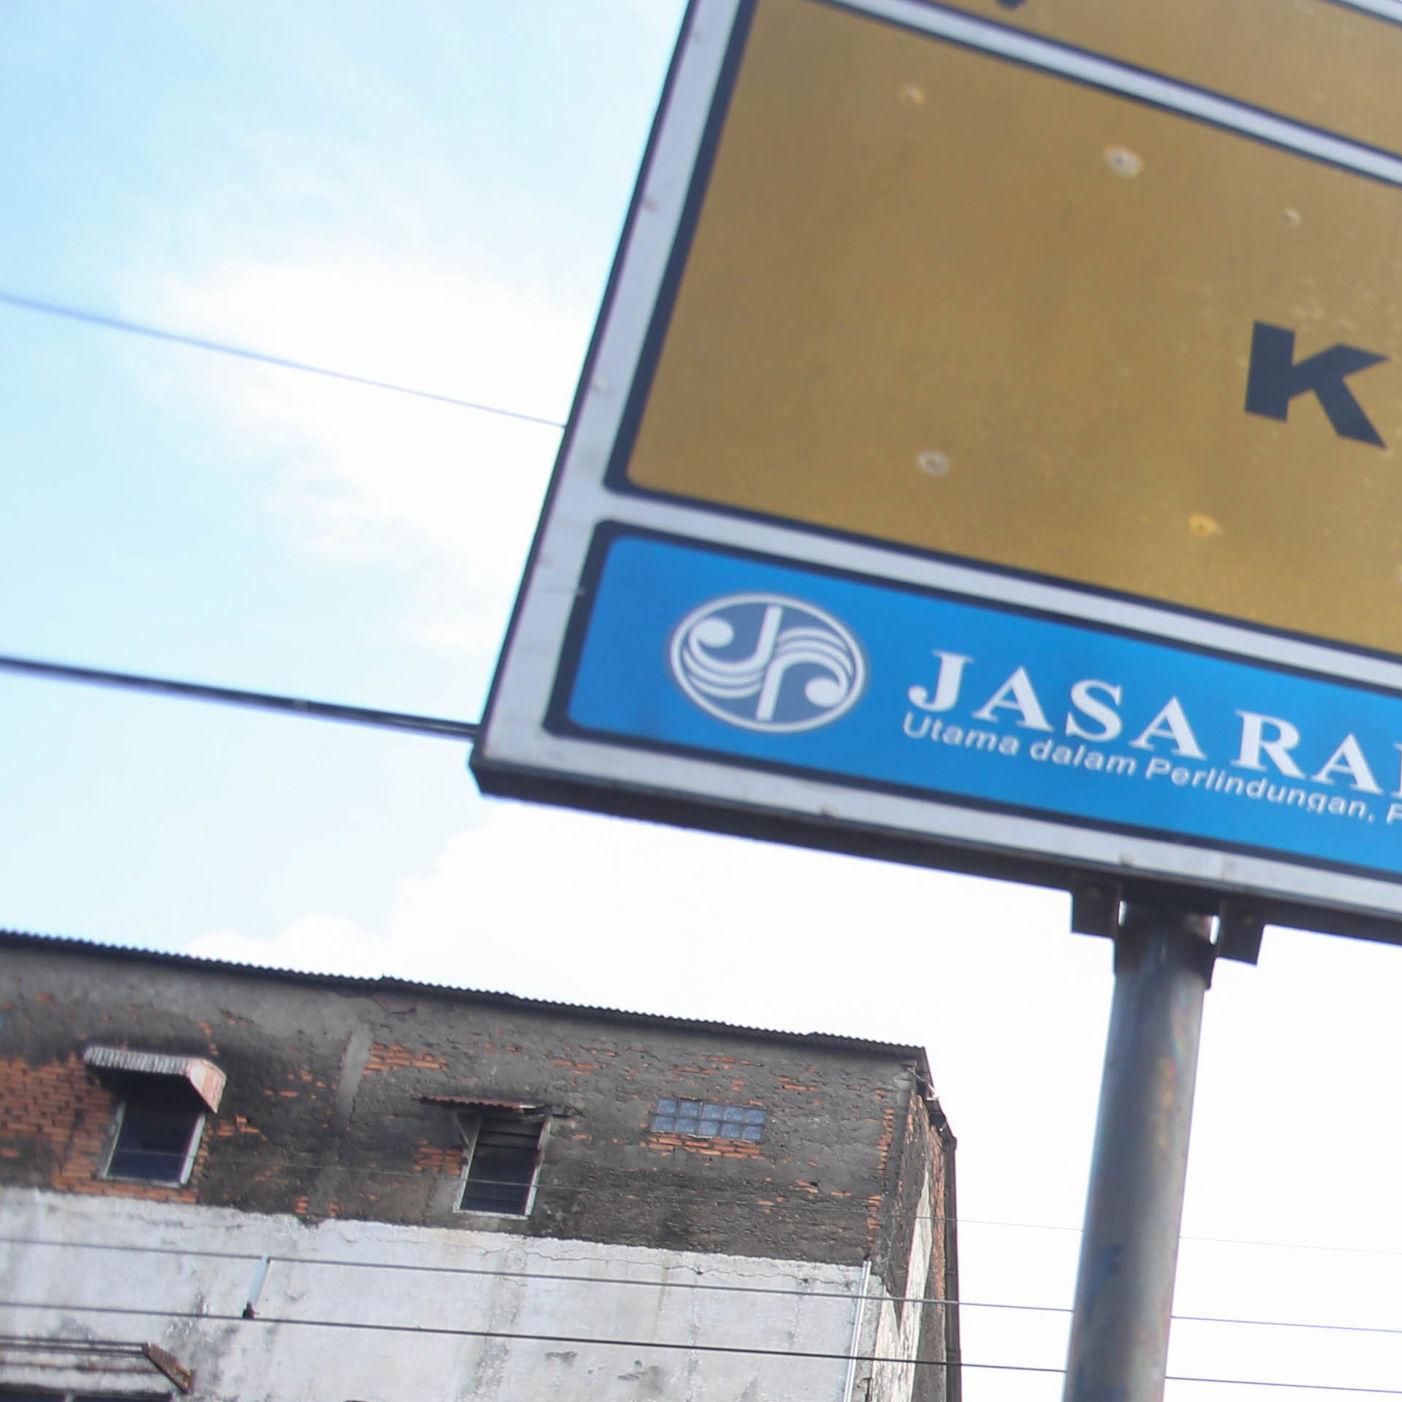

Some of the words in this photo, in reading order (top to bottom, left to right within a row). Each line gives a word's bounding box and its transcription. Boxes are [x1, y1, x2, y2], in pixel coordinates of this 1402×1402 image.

[907, 649, 1208, 760] JASA
[903, 711, 1019, 757] Utama
[1030, 738, 1136, 777] dalam
[1145, 759, 1374, 824] Perlindungan,
